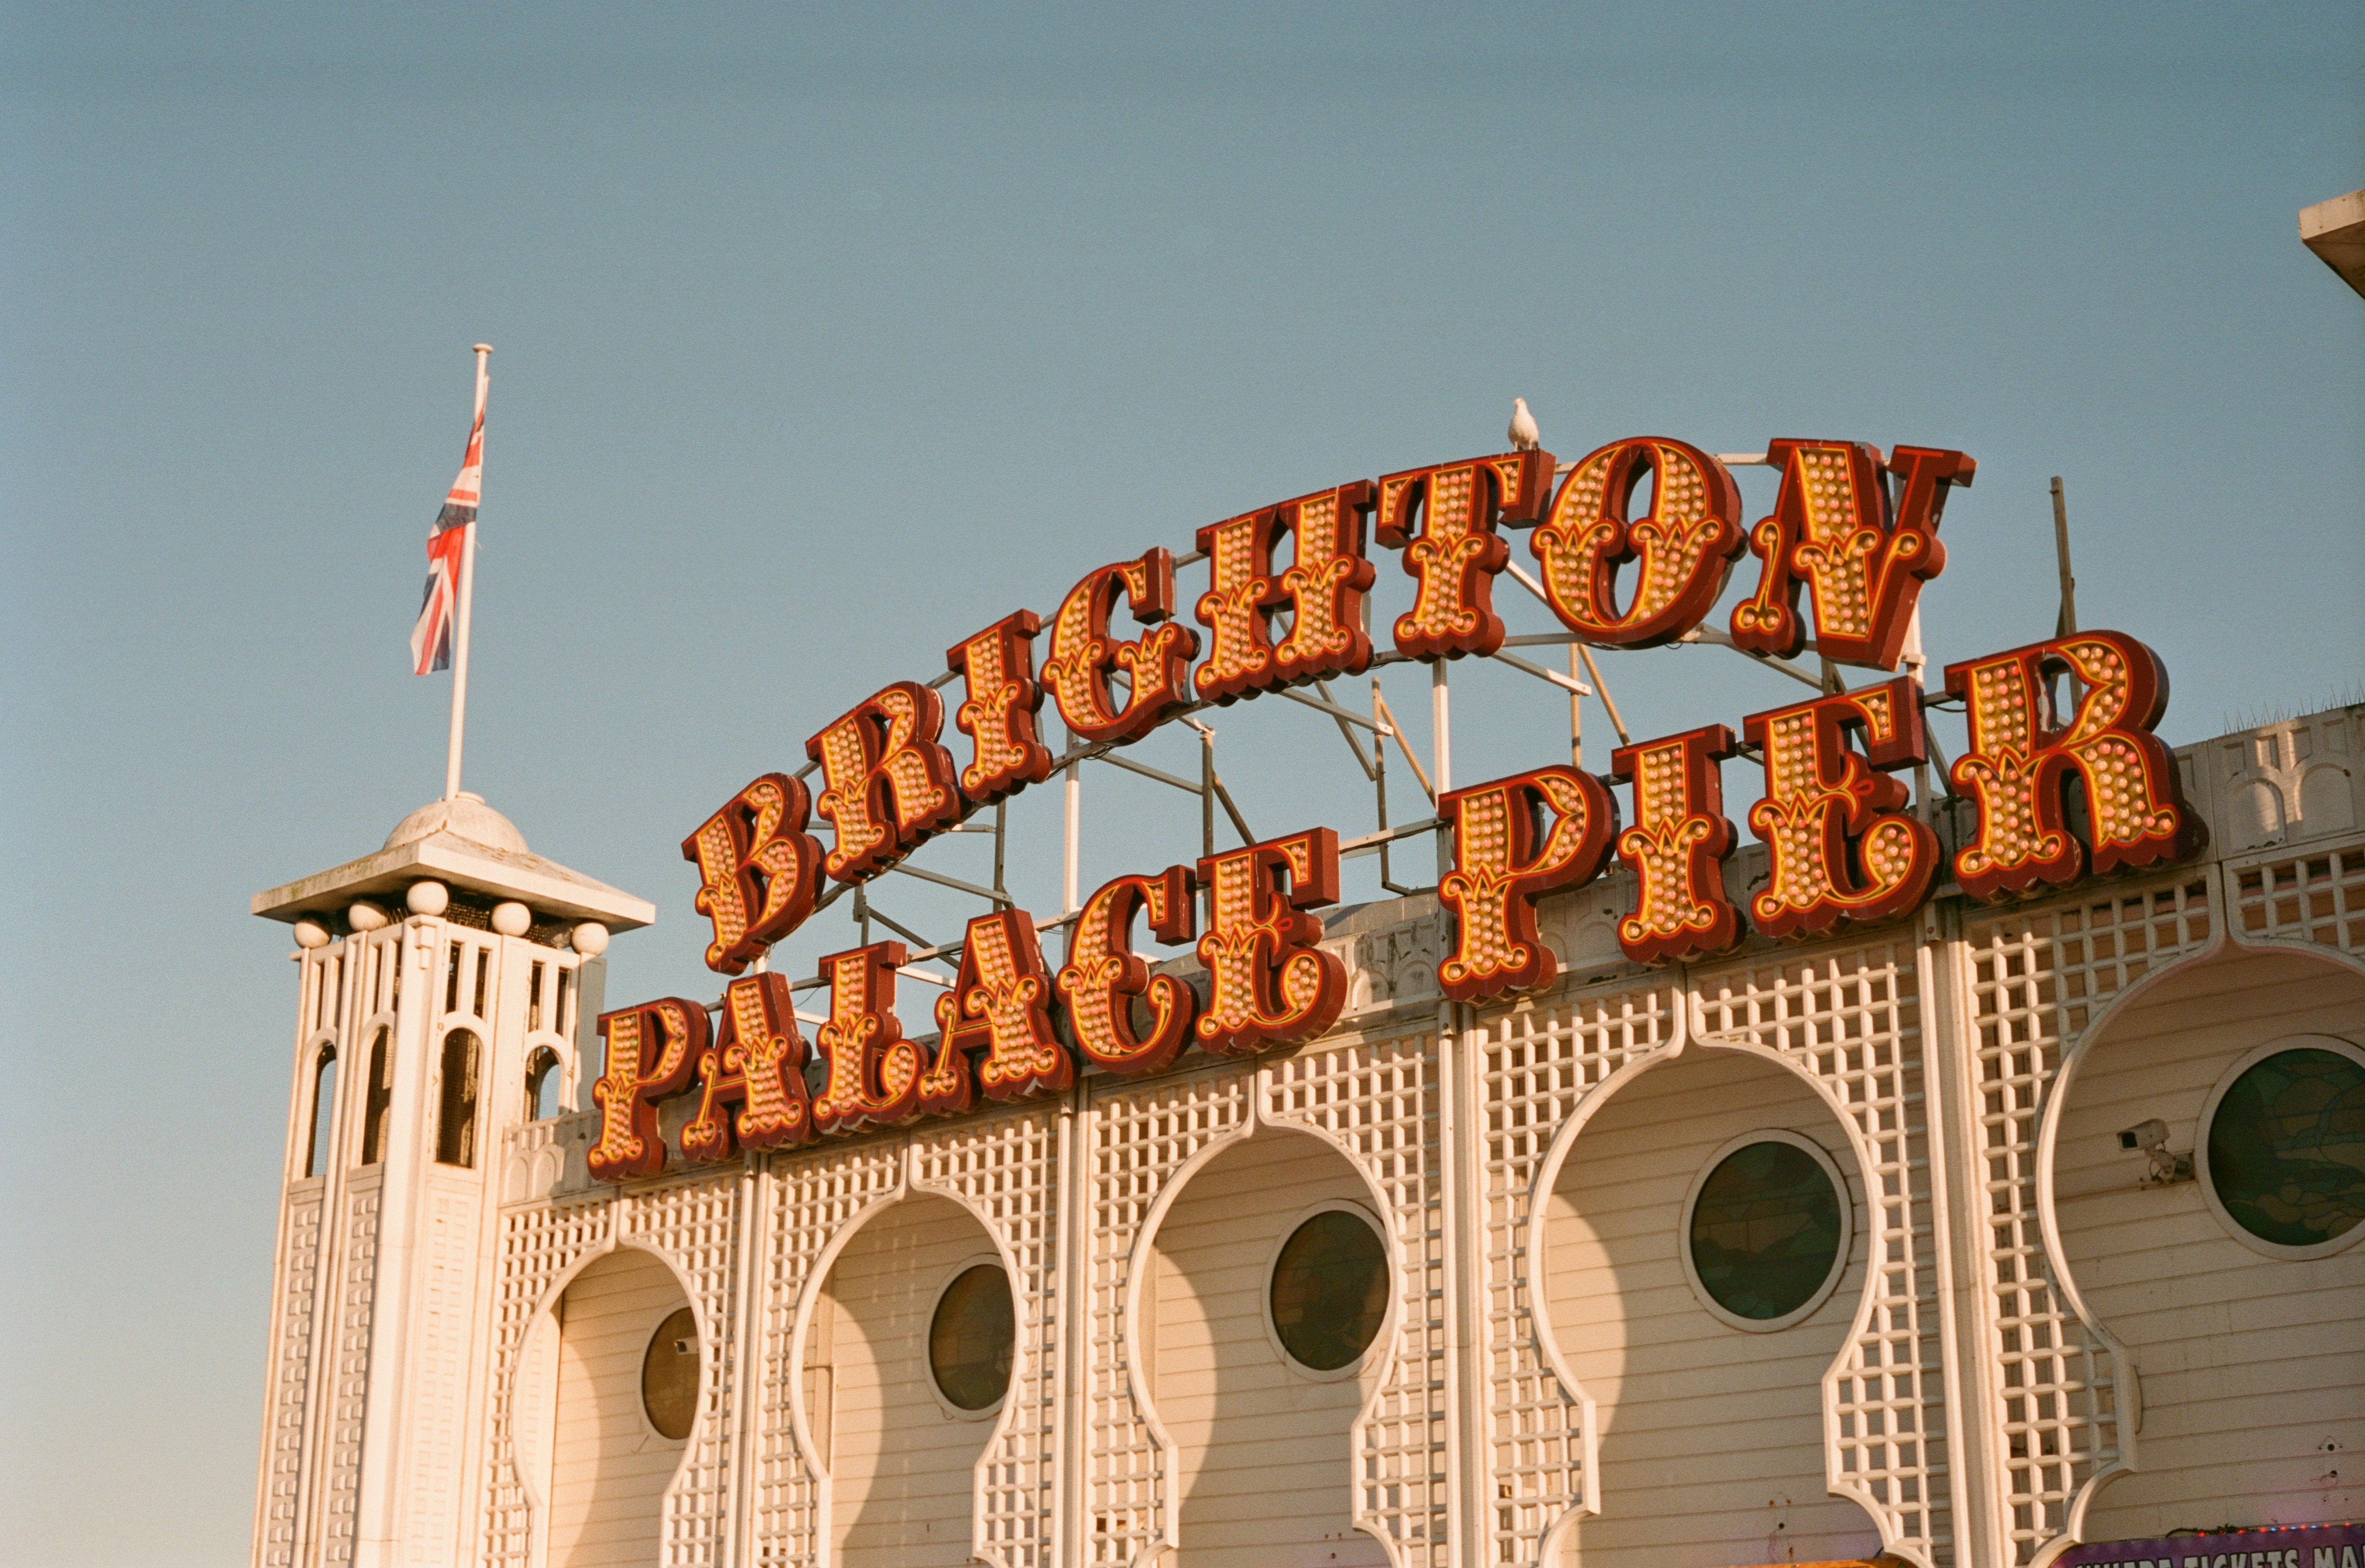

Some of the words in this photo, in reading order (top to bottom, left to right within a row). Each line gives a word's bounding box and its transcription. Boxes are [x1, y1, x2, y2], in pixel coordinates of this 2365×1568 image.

[588, 827, 1345, 1180] PALACE
[1438, 629, 2209, 1004] PIER
[681, 436, 1977, 975] BRIGHTON
